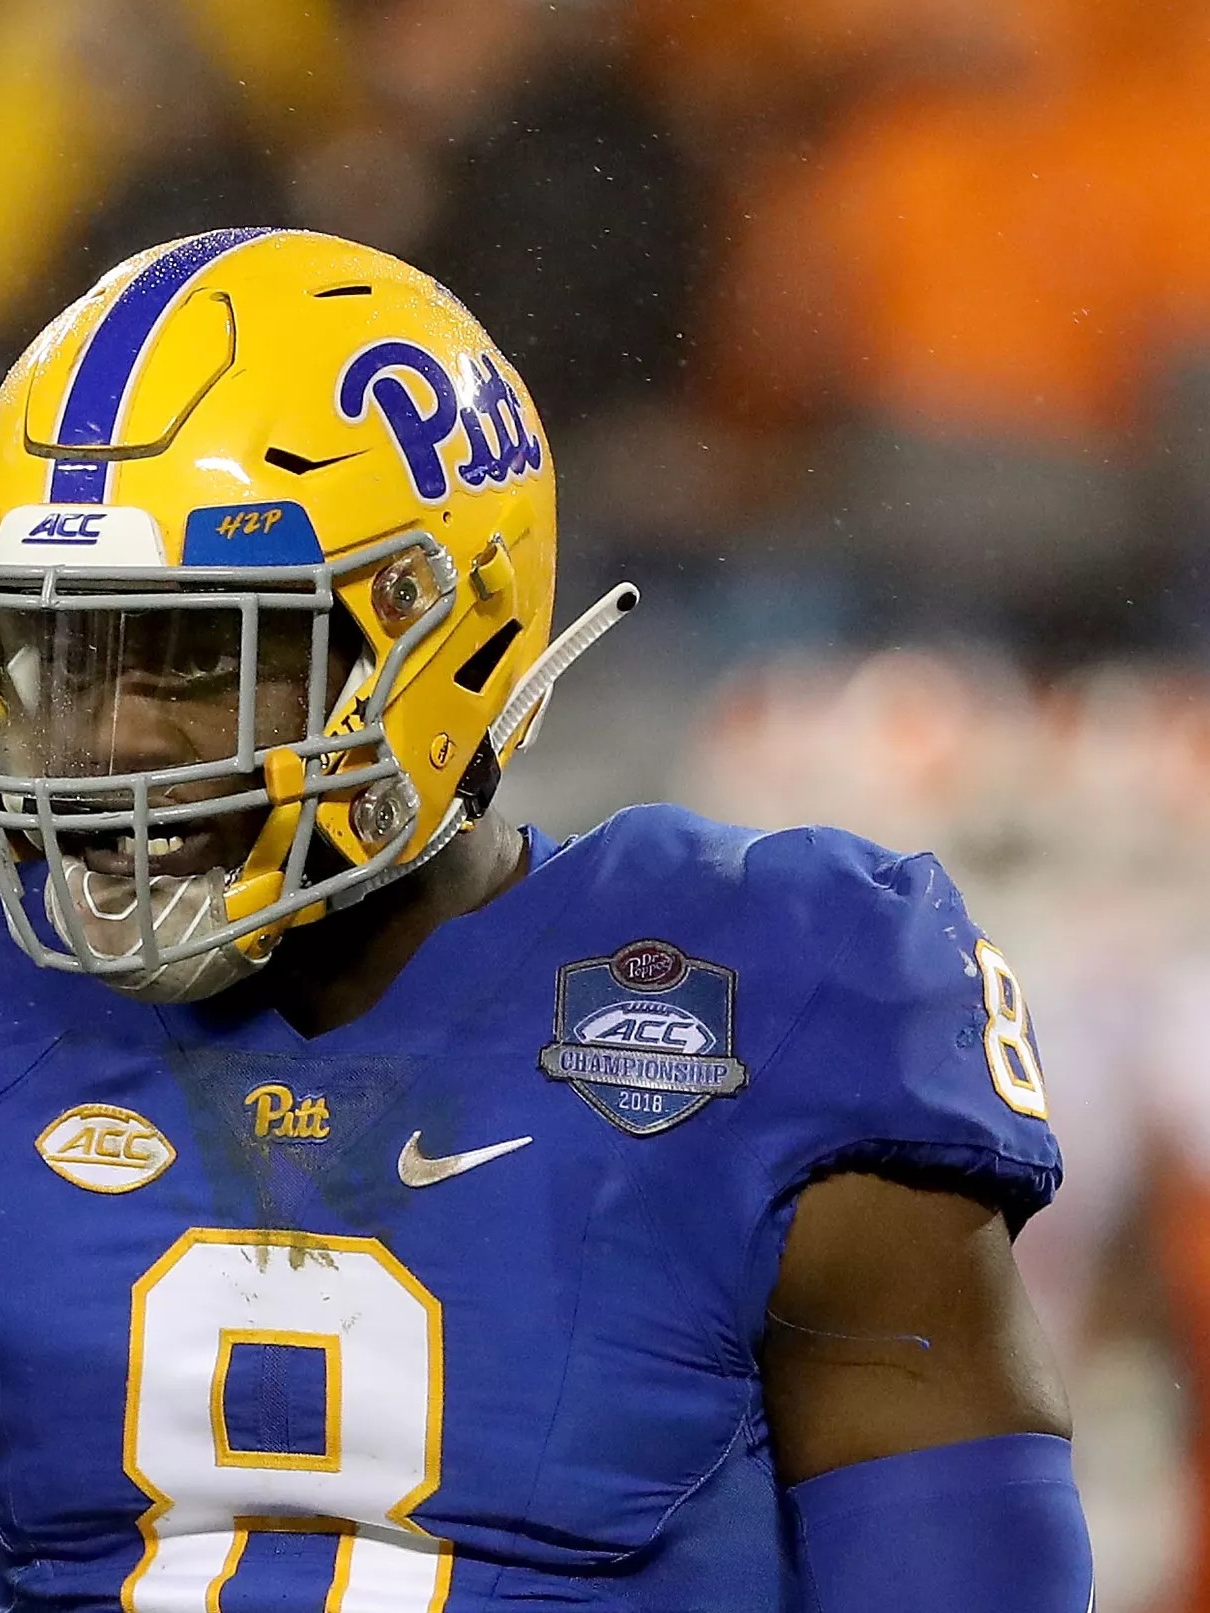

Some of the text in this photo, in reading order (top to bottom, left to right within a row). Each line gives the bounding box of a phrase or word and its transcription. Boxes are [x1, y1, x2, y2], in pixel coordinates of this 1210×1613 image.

[336, 339, 542, 502] Pitt
[28, 513, 108, 538] ACC
[595, 1018, 695, 1047] ACC
[974, 938, 1050, 1121] 8
[558, 1049, 728, 1087] CHAMPIONSHIP
[244, 1083, 331, 1138] Pitt
[618, 1091, 663, 1113] 2018
[56, 1124, 158, 1160] ACC
[121, 1227, 454, 1613] 8
